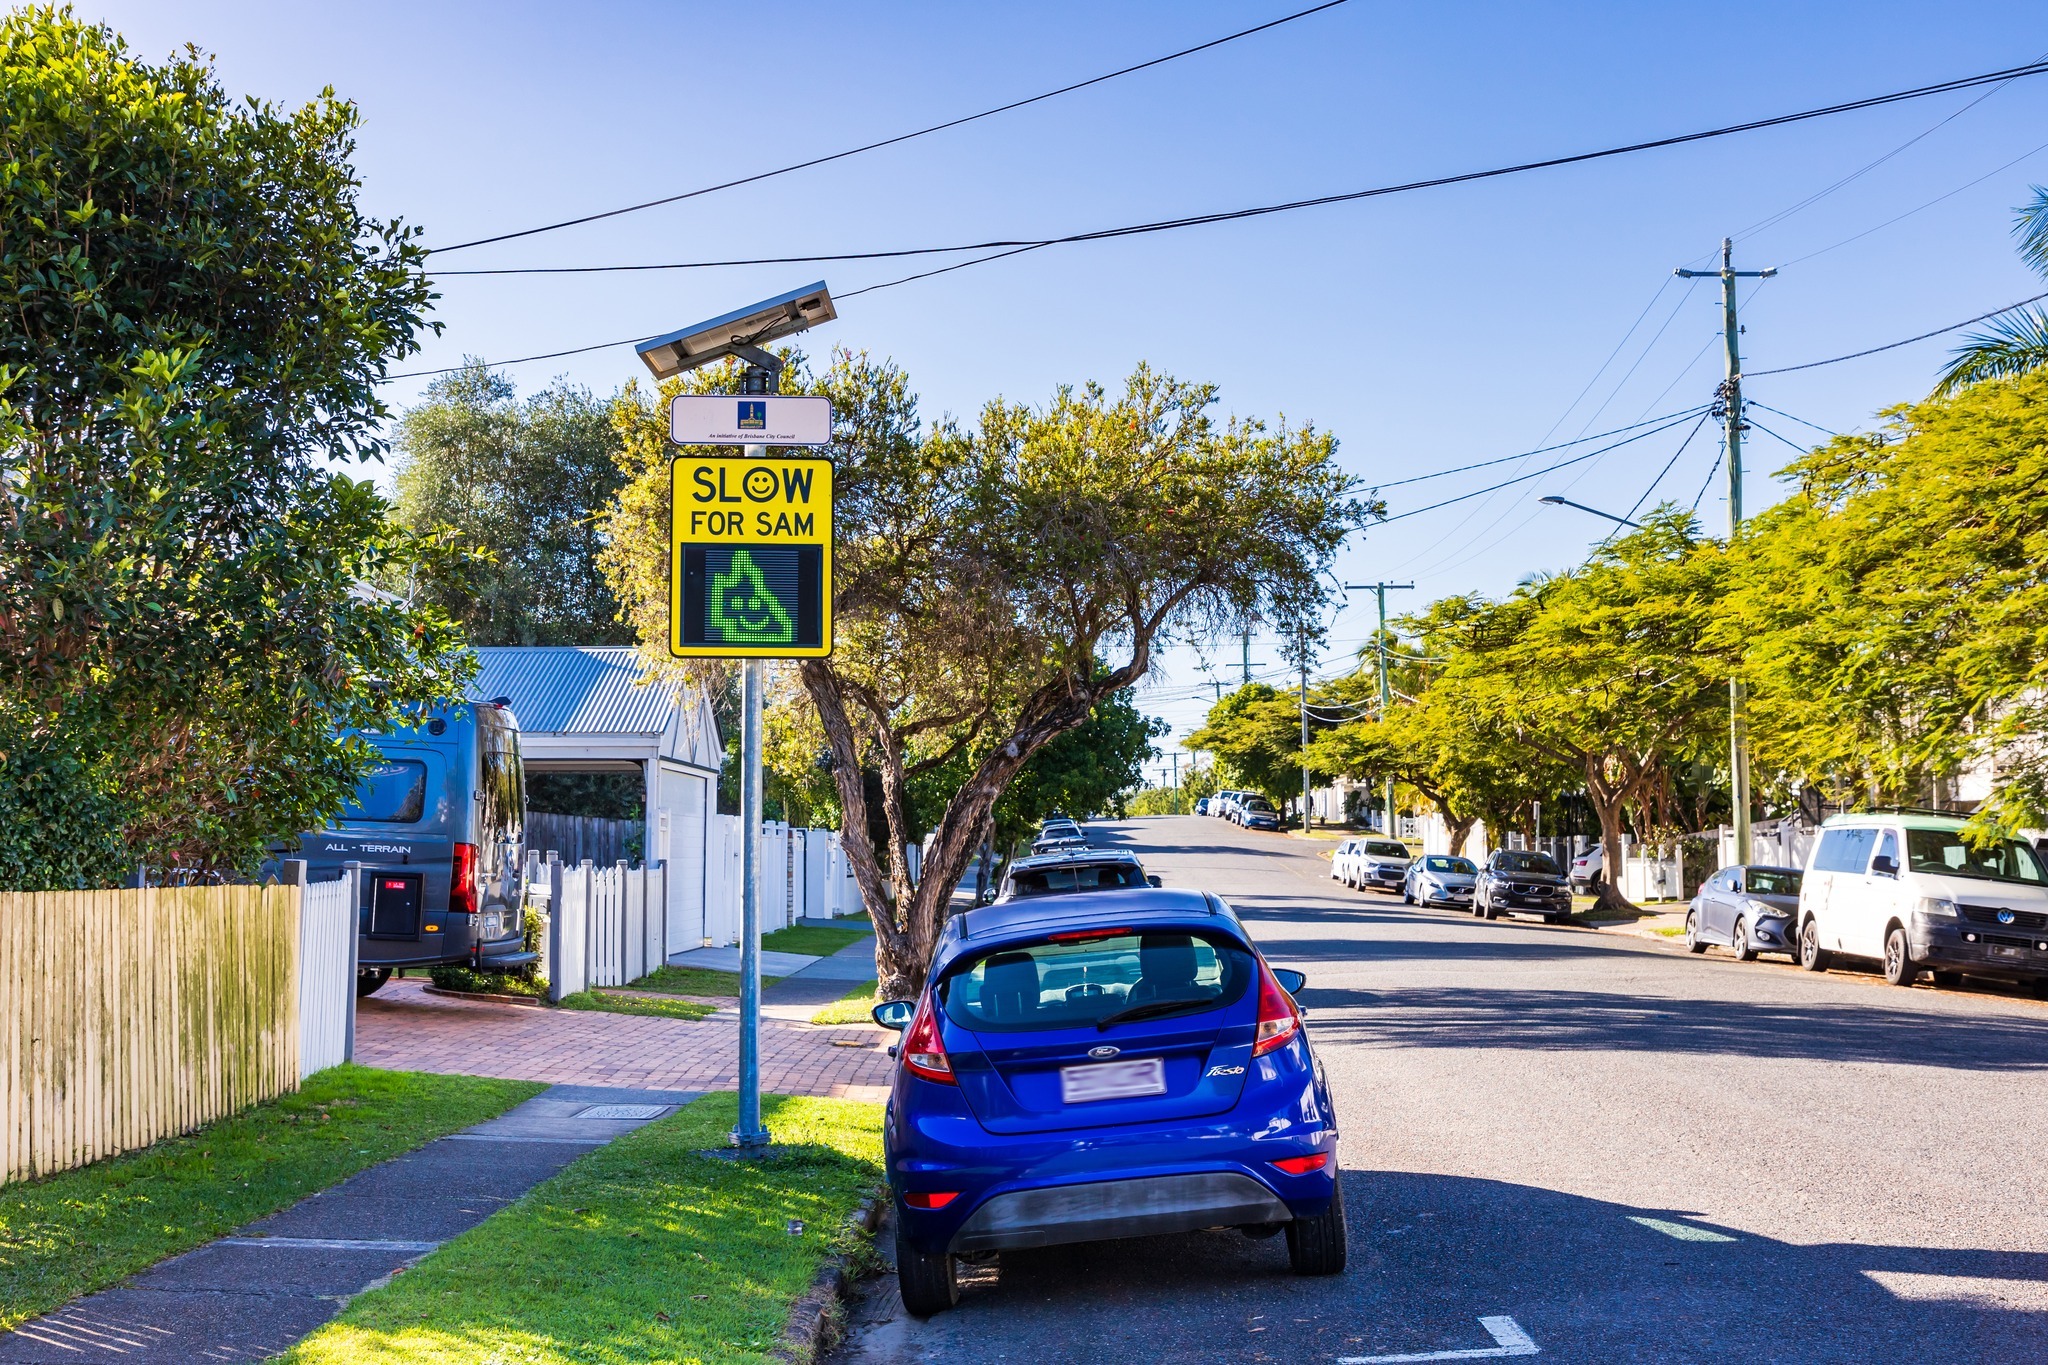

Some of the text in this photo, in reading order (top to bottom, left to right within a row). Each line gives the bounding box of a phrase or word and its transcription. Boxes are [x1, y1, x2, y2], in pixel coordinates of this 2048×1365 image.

[692, 466, 814, 504] SLOW
[691, 511, 814, 536] FOR SAM
[325, 843, 348, 852] ALL
[360, 844, 411, 854] TERRAIN
